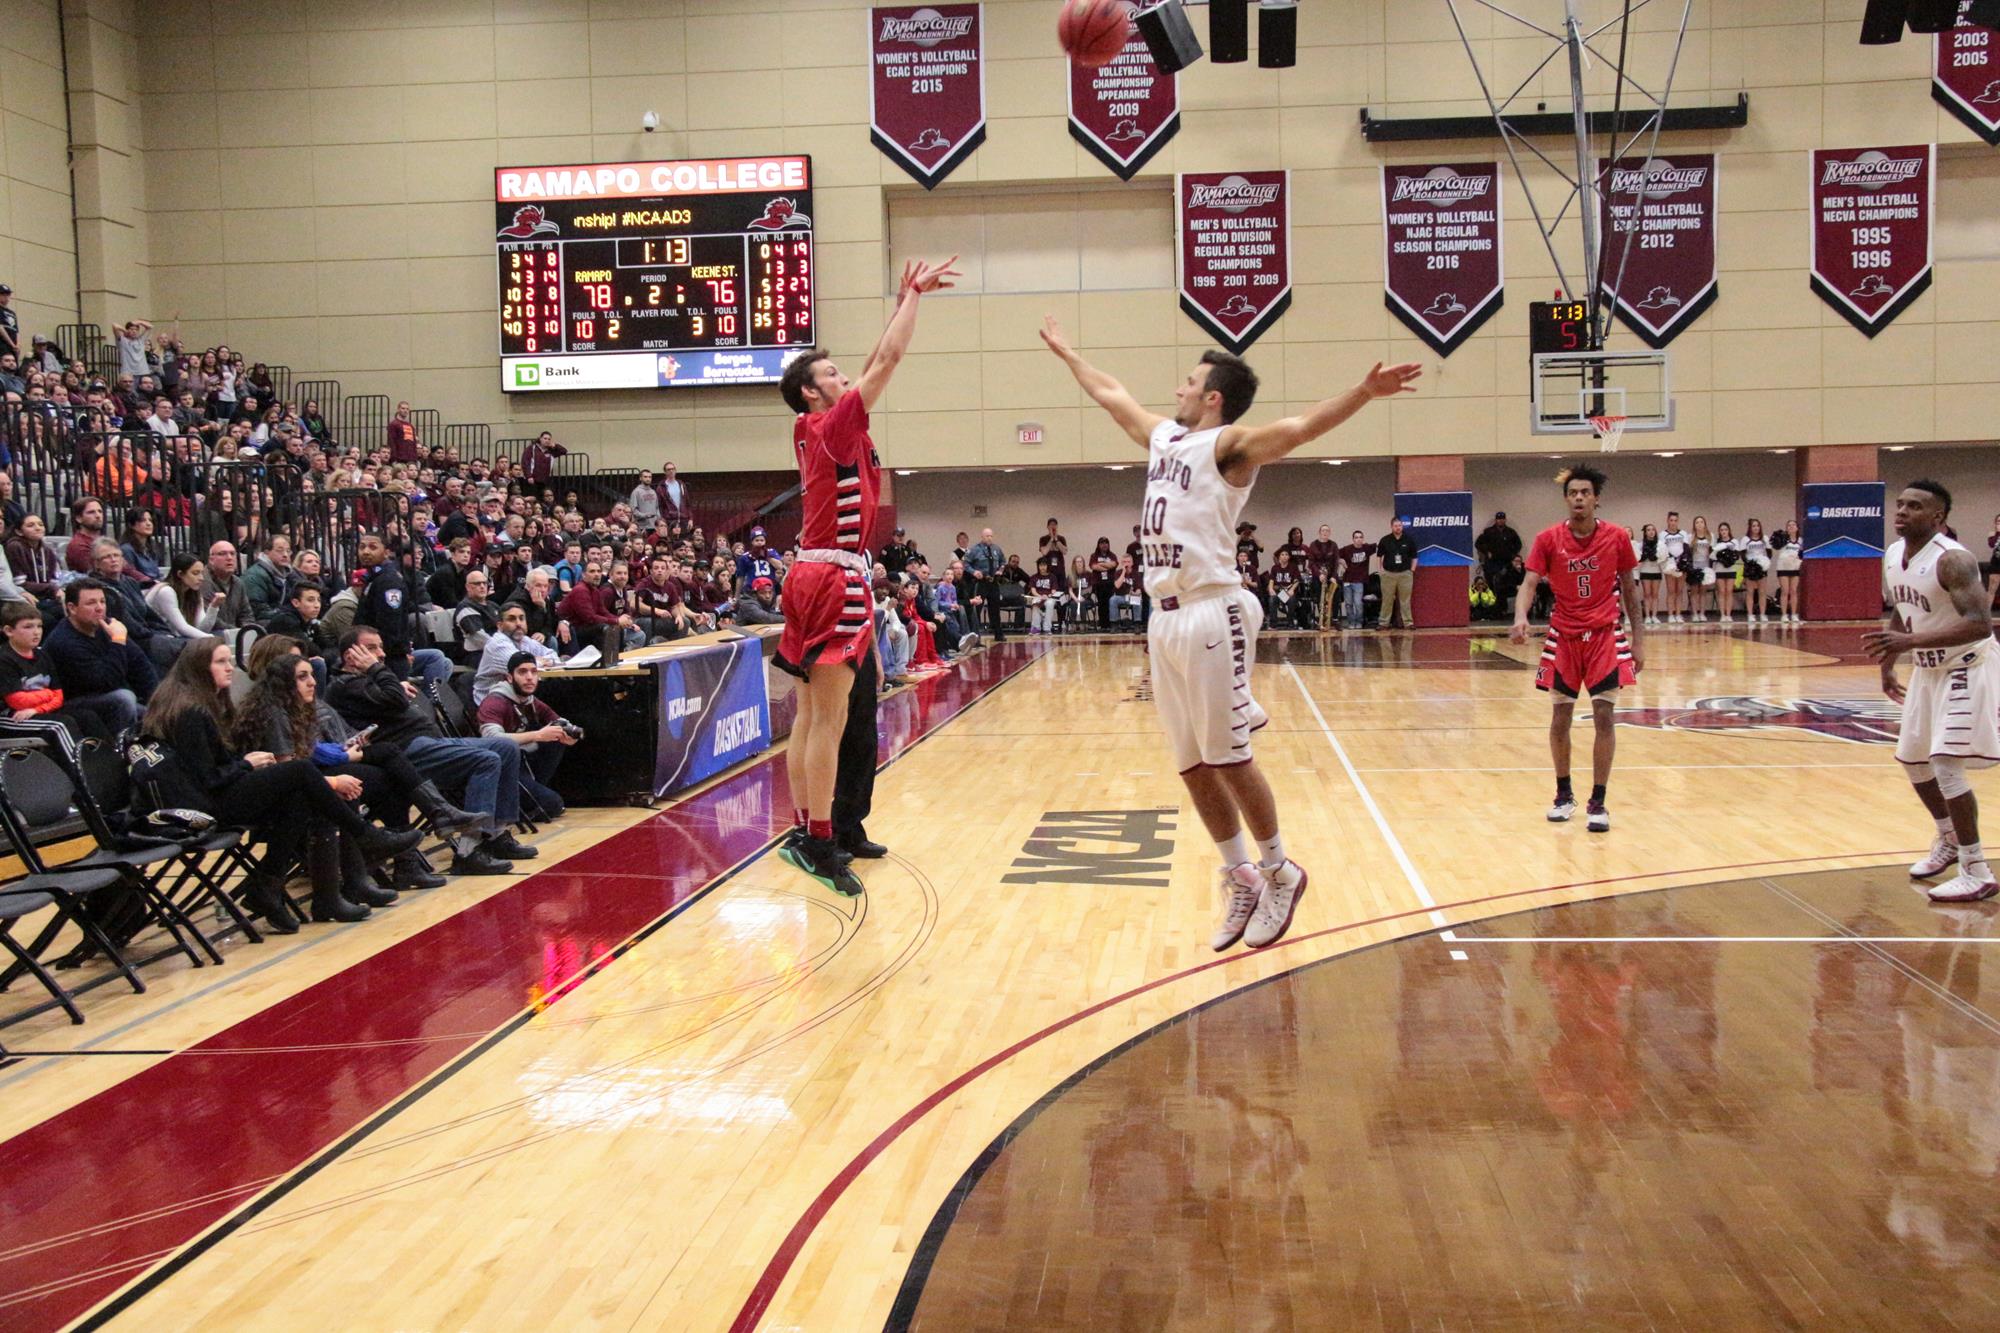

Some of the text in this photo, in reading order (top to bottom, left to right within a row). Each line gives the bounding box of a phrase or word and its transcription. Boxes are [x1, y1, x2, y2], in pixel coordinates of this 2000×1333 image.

[883, 17, 969, 38] RAMAPO COLLEGE
[1122, 42, 1149, 52] VISIO
[1954, 32, 1988, 47] 2003
[876, 49, 977, 64] WOMEN'S VOLLEYBALL
[1953, 51, 1988, 66] 2005
[886, 63, 967, 78] ECAC CHAMPIONS
[1098, 65, 1147, 77] VOLLEYBALL
[912, 79, 943, 93] 2015
[1092, 77, 1154, 89] CHAMPIONSHIP
[1097, 89, 1150, 100] APPEARANCE
[1109, 103, 1139, 117] 2009
[1661, 168, 1703, 183] COLLEGE
[1826, 159, 1918, 182] RAMAPO COLLEGE
[502, 161, 804, 198] RAMAPO COLLEGE
[1396, 176, 1486, 198] RAMAPO COLLEGE
[1193, 184, 1277, 205] RAMAPO COLLEGE
[1630, 183, 1688, 192] RODRUNNERS
[1823, 193, 1919, 208] MEN'S VOLLEYBALL
[1389, 210, 1495, 224] WOMEN'S VOLLEYBALL
[1610, 203, 1704, 217] MEN' VOLLEYBALL
[1823, 207, 1919, 222] NECVA CHAMPIONS
[622, 210, 691, 226] #NCAAD3
[1190, 217, 1278, 230] MEN'S VOLLEYBALL
[1642, 218, 1701, 231] CHAMPIONS
[1198, 231, 1271, 243] METRO DIVISION
[1406, 225, 1479, 239] NJAC REGULAR
[1851, 227, 1891, 245] 1995
[1394, 239, 1492, 253] SEASON CHAMPIONS
[1641, 234, 1674, 248] 2012
[644, 238, 687, 264] 1:13
[761, 243, 808, 259] 0 4 19
[1194, 244, 1275, 257] REGULAR SEASON
[512, 252, 557, 268] 3 4 8
[1207, 258, 1262, 270] CHAMPIONS
[1427, 255, 1459, 270] 2016
[1851, 250, 1891, 269] 1996
[765, 260, 808, 275] 1 3 3
[511, 271, 557, 284] 4 3 14
[575, 270, 612, 283] RAMAPO
[641, 274, 667, 283] PERIOD
[1192, 274, 1279, 287] 1996 2001 2009
[706, 280, 735, 304] 76
[762, 277, 808, 293] 5 2 27
[507, 286, 558, 302] 10 2 8
[583, 285, 611, 308] 78
[648, 285, 661, 305] 2
[757, 295, 809, 310] 13 2 4
[503, 304, 558, 318] 21 0 11
[572, 310, 624, 320] FOULS T.O.L.
[631, 308, 679, 318] PLAYER FOUL
[687, 306, 738, 316] T.O.L. FOULS
[1552, 304, 1583, 320] 1:13
[692, 315, 735, 336] 3 10
[754, 312, 809, 327] 35 3 12
[503, 320, 559, 336] 40 3 10
[576, 319, 620, 339] 10 2
[1561, 321, 1577, 348] 5
[715, 337, 739, 346] SCORE
[777, 329, 786, 343] 0
[527, 338, 536, 352] 0
[572, 342, 596, 351] SCORE
[643, 340, 669, 348] MATCH
[545, 367, 580, 377] Bank
[1023, 430, 1038, 441] EXIT
[1143, 496, 1167, 536] 10
[1822, 507, 1881, 518] BASKETBALL
[1412, 515, 1470, 528] BASKETBALL
[753, 560, 771, 576] 13
[1568, 556, 1600, 573] KSC
[1577, 574, 1592, 599] 5
[713, 704, 762, 757] BASKETBALL
[1000, 809, 1180, 888] NCAA
